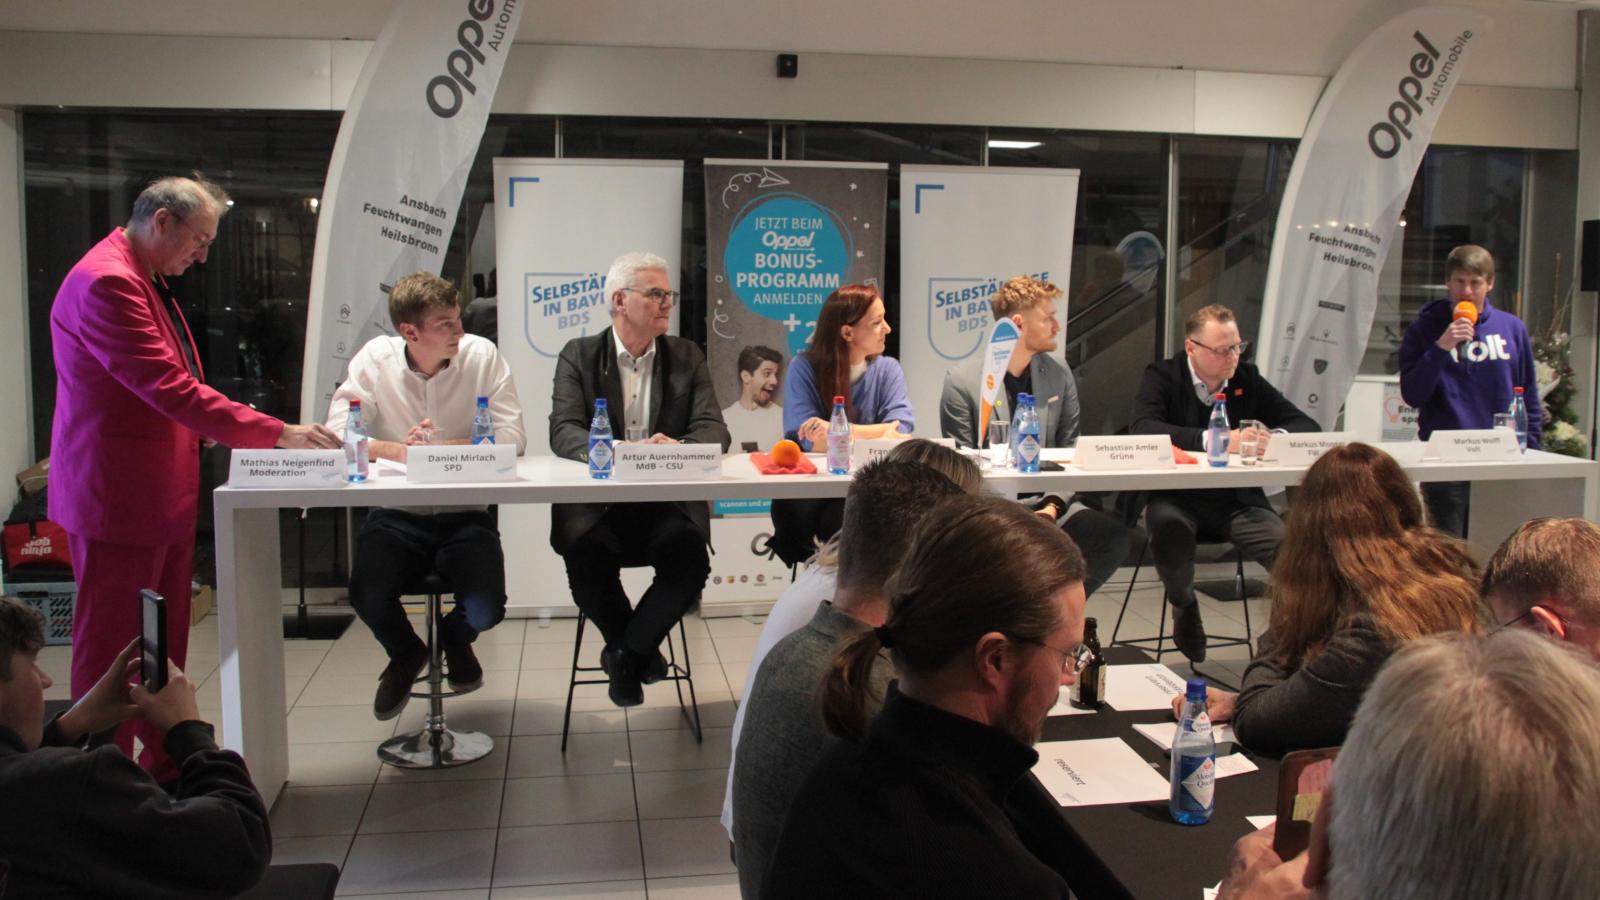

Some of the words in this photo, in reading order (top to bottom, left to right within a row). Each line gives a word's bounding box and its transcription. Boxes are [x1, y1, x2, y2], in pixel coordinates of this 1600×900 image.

[1426, 29, 1473, 107] Automobile
[1368, 30, 1440, 159] Oppel
[400, 195, 447, 219] Ansbach
[363, 203, 442, 237] Feuchtwangen
[755, 217, 788, 230] JETZT
[792, 218, 823, 230] BEIM
[381, 226, 439, 255] Heilsbronn
[762, 231, 815, 250] Oppel
[755, 253, 823, 269] BONUS-
[736, 273, 840, 288] PROGRAMM
[753, 293, 823, 304] ANMELDEN
[543, 301, 562, 317] IN
[945, 306, 962, 320] IN
[557, 311, 591, 330] BDS
[958, 315, 989, 333] BDS
[1095, 443, 1134, 451] Sebastian
[428, 455, 458, 463] Daniel
[460, 453, 496, 462] Mirlach
[622, 453, 647, 461] Artur
[649, 452, 716, 461] Auernhammer
[1110, 451, 1135, 460] Grüne
[240, 459, 280, 467] Mathias
[281, 458, 335, 469] Neigenfind
[444, 464, 462, 472] SPD
[249, 468, 306, 477] Moderation
[25, 536, 51, 548] job
[20, 546, 52, 556] ninja
